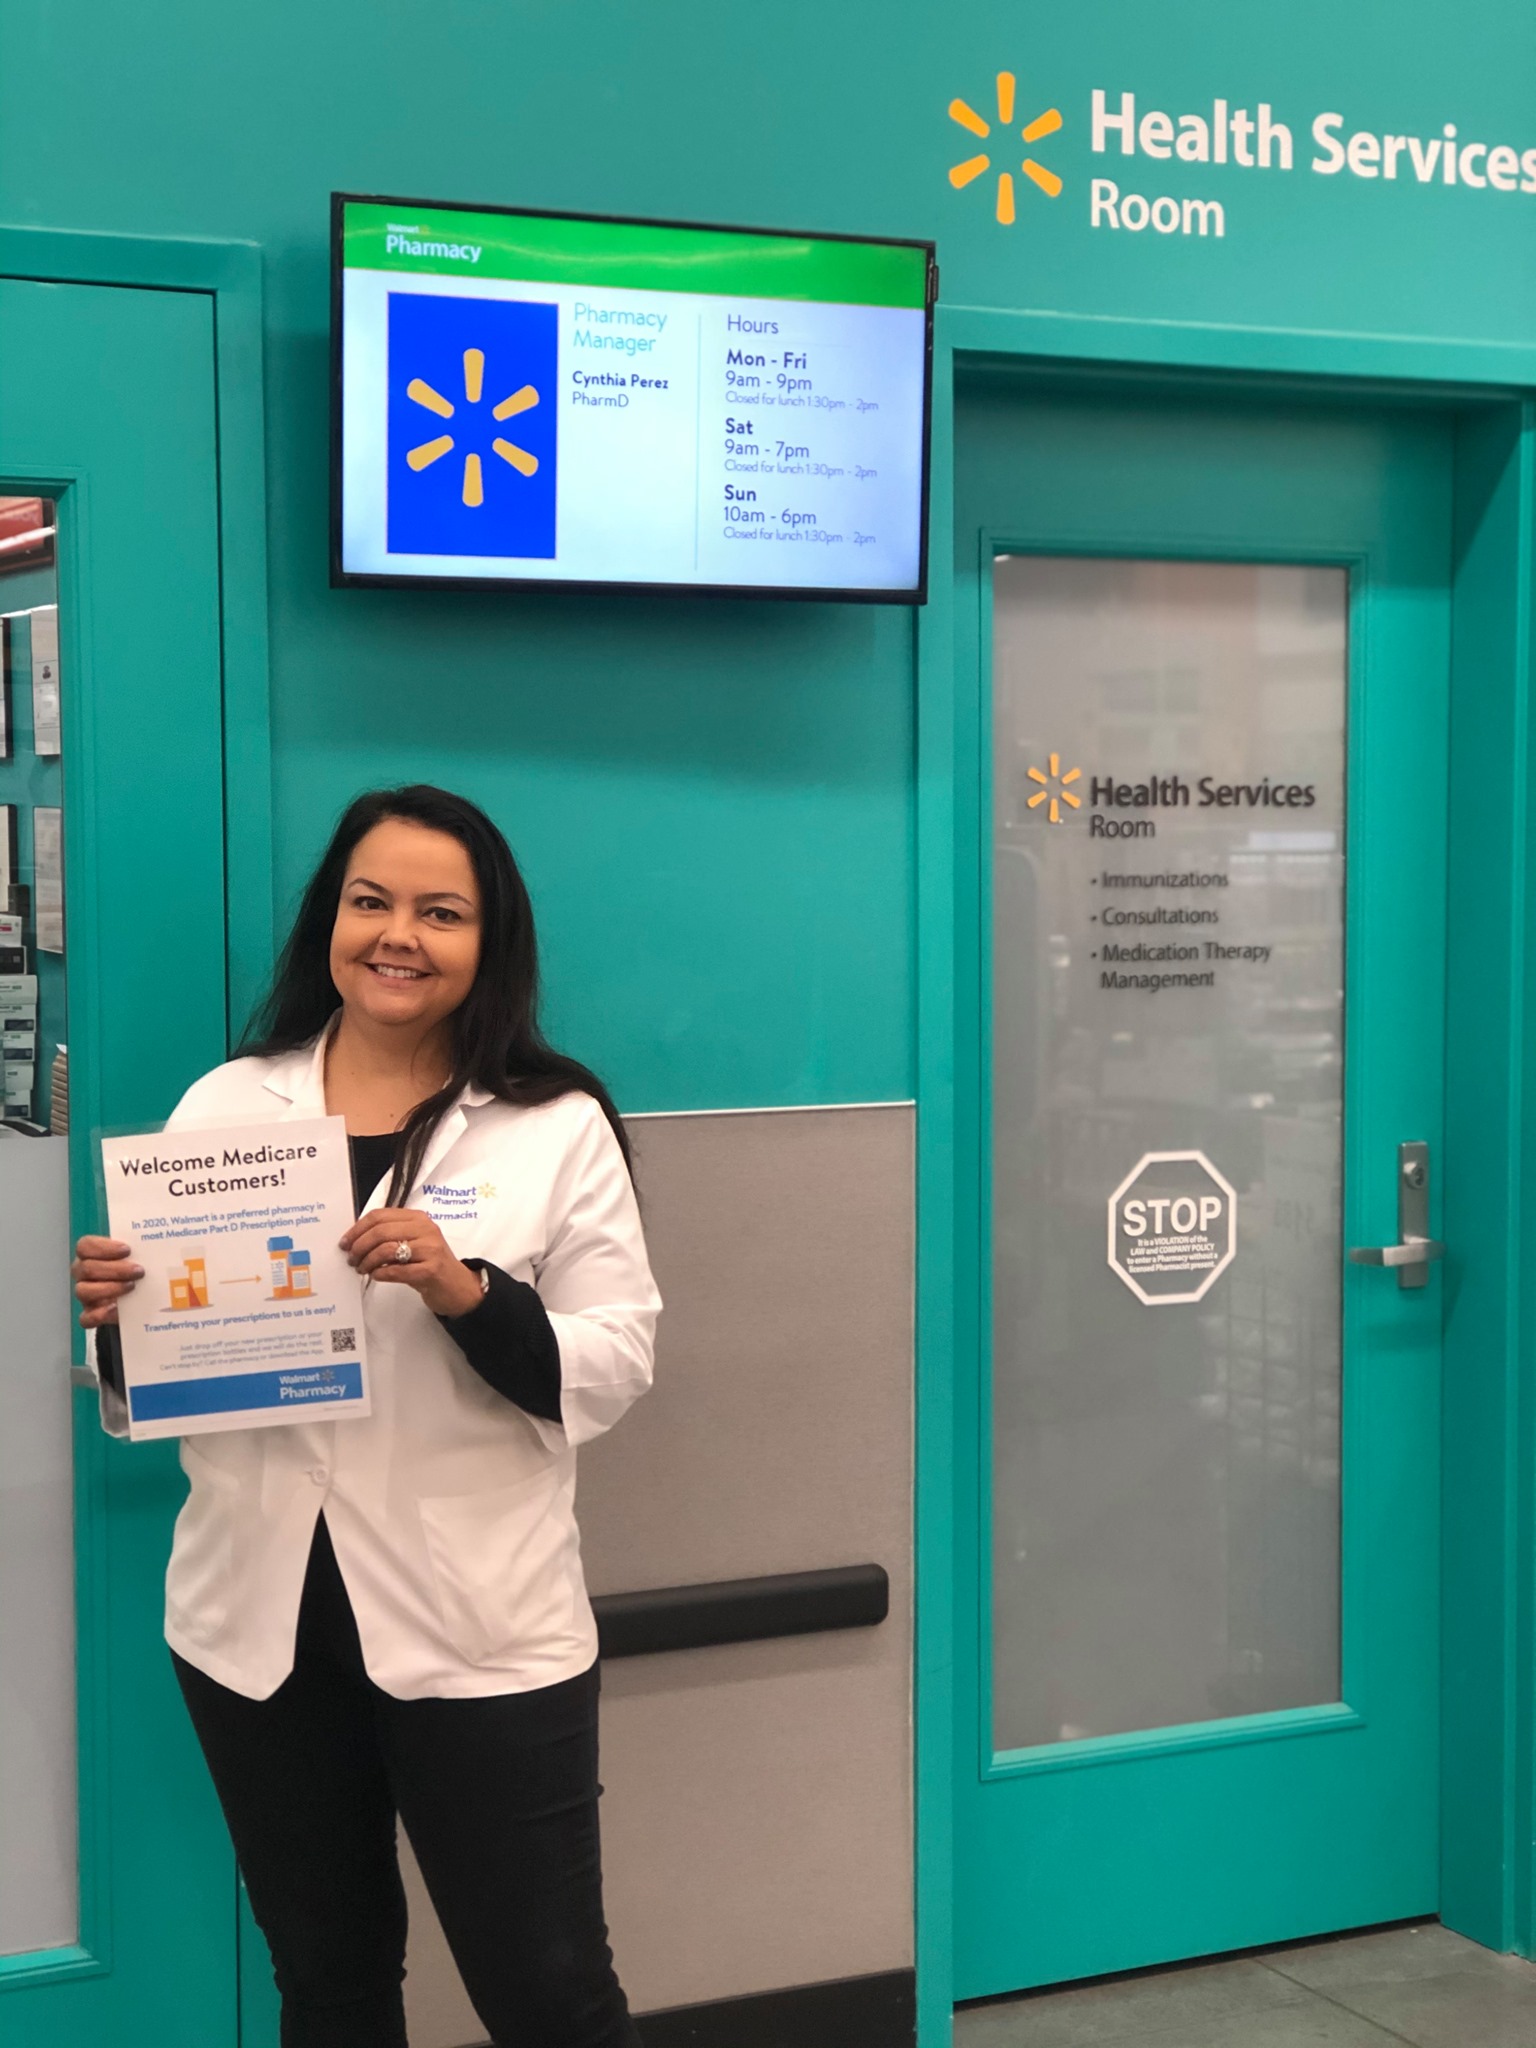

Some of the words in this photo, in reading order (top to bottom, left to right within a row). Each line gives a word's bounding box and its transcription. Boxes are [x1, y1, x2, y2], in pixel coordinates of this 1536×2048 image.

[1091, 88, 1293, 170] Health
[1311, 112, 1536, 194] Services
[1091, 178, 1225, 237] Room
[386, 234, 482, 263] Pharmacy
[574, 303, 668, 332] Pharmacy
[727, 314, 779, 335] Hours
[573, 330, 656, 356] Manager
[726, 349, 766, 368] Mon
[783, 352, 807, 369] Fri
[572, 371, 626, 388] Cynthia
[630, 374, 669, 390] Perez
[725, 370, 760, 388] 9am
[776, 373, 812, 394] 9pm
[572, 391, 629, 408] PharmD
[725, 390, 760, 404] Closed
[762, 392, 776, 405] for
[778, 393, 805, 406] lunch
[856, 398, 879, 414] 2pm
[725, 418, 754, 435] Sat
[725, 439, 759, 456] 9am
[775, 441, 810, 461] 7pm
[724, 458, 758, 473] Closed
[761, 460, 775, 473] for
[777, 461, 804, 475] lunch
[855, 465, 878, 482] 2pm
[724, 484, 757, 502] Sun
[724, 506, 765, 524] 10am
[781, 508, 817, 528] 6pm
[723, 526, 757, 540] Closed
[760, 528, 774, 540] for
[776, 528, 802, 541] lunch
[853, 531, 876, 547] 2pm
[1090, 775, 1190, 807] Health
[1198, 777, 1316, 808] Services
[1089, 814, 1155, 838] Room
[1102, 871, 1229, 889] Immunizations
[1101, 906, 1219, 926] Consultations
[1102, 943, 1199, 962] Medication
[1203, 942, 1272, 962] Therapy
[1100, 970, 1215, 992] Management
[120, 1154, 215, 1177] Welcome
[222, 1145, 318, 1168] Medicare
[168, 1169, 286, 1197] Customers!
[423, 1184, 477, 1197] Walmart
[432, 1196, 477, 1206] Pharmacy
[132, 1220, 140, 1229] In
[142, 1217, 169, 1228] 2020,
[170, 1214, 209, 1225] Walmart
[211, 1212, 218, 1221] is
[227, 1207, 270, 1221] preferred
[271, 1204, 315, 1218] pharmacy
[317, 1202, 325, 1210] in
[426, 1210, 478, 1220] harmacist
[1123, 1195, 1222, 1236] STOP
[141, 1232, 164, 1241] most
[165, 1227, 208, 1238] Medicare
[209, 1224, 229, 1234] Part
[230, 1222, 238, 1232] D
[240, 1217, 294, 1231] Prescription
[295, 1215, 320, 1227] plans.
[1130, 1247, 1145, 1256] LAW
[1146, 1247, 1158, 1255] and
[1159, 1244, 1191, 1253] COMPANY
[1192, 1242, 1215, 1252] POLICY
[1154, 1236, 1189, 1245] VIOLATION
[1190, 1235, 1196, 1243] of
[1197, 1235, 1208, 1243] the
[1157, 1254, 1189, 1264] Pharmacy
[144, 1319, 199, 1333] Transferring
[201, 1317, 221, 1328] your
[223, 1312, 280, 1327] prescriptions
[282, 1310, 292, 1319] to
[294, 1309, 303, 1317] us
[305, 1307, 312, 1316] is
[314, 1305, 336, 1316] easy!
[256, 1333, 297, 1344] prescription
[279, 1372, 320, 1385] Walmart
[280, 1384, 346, 1399] Pharmacy
